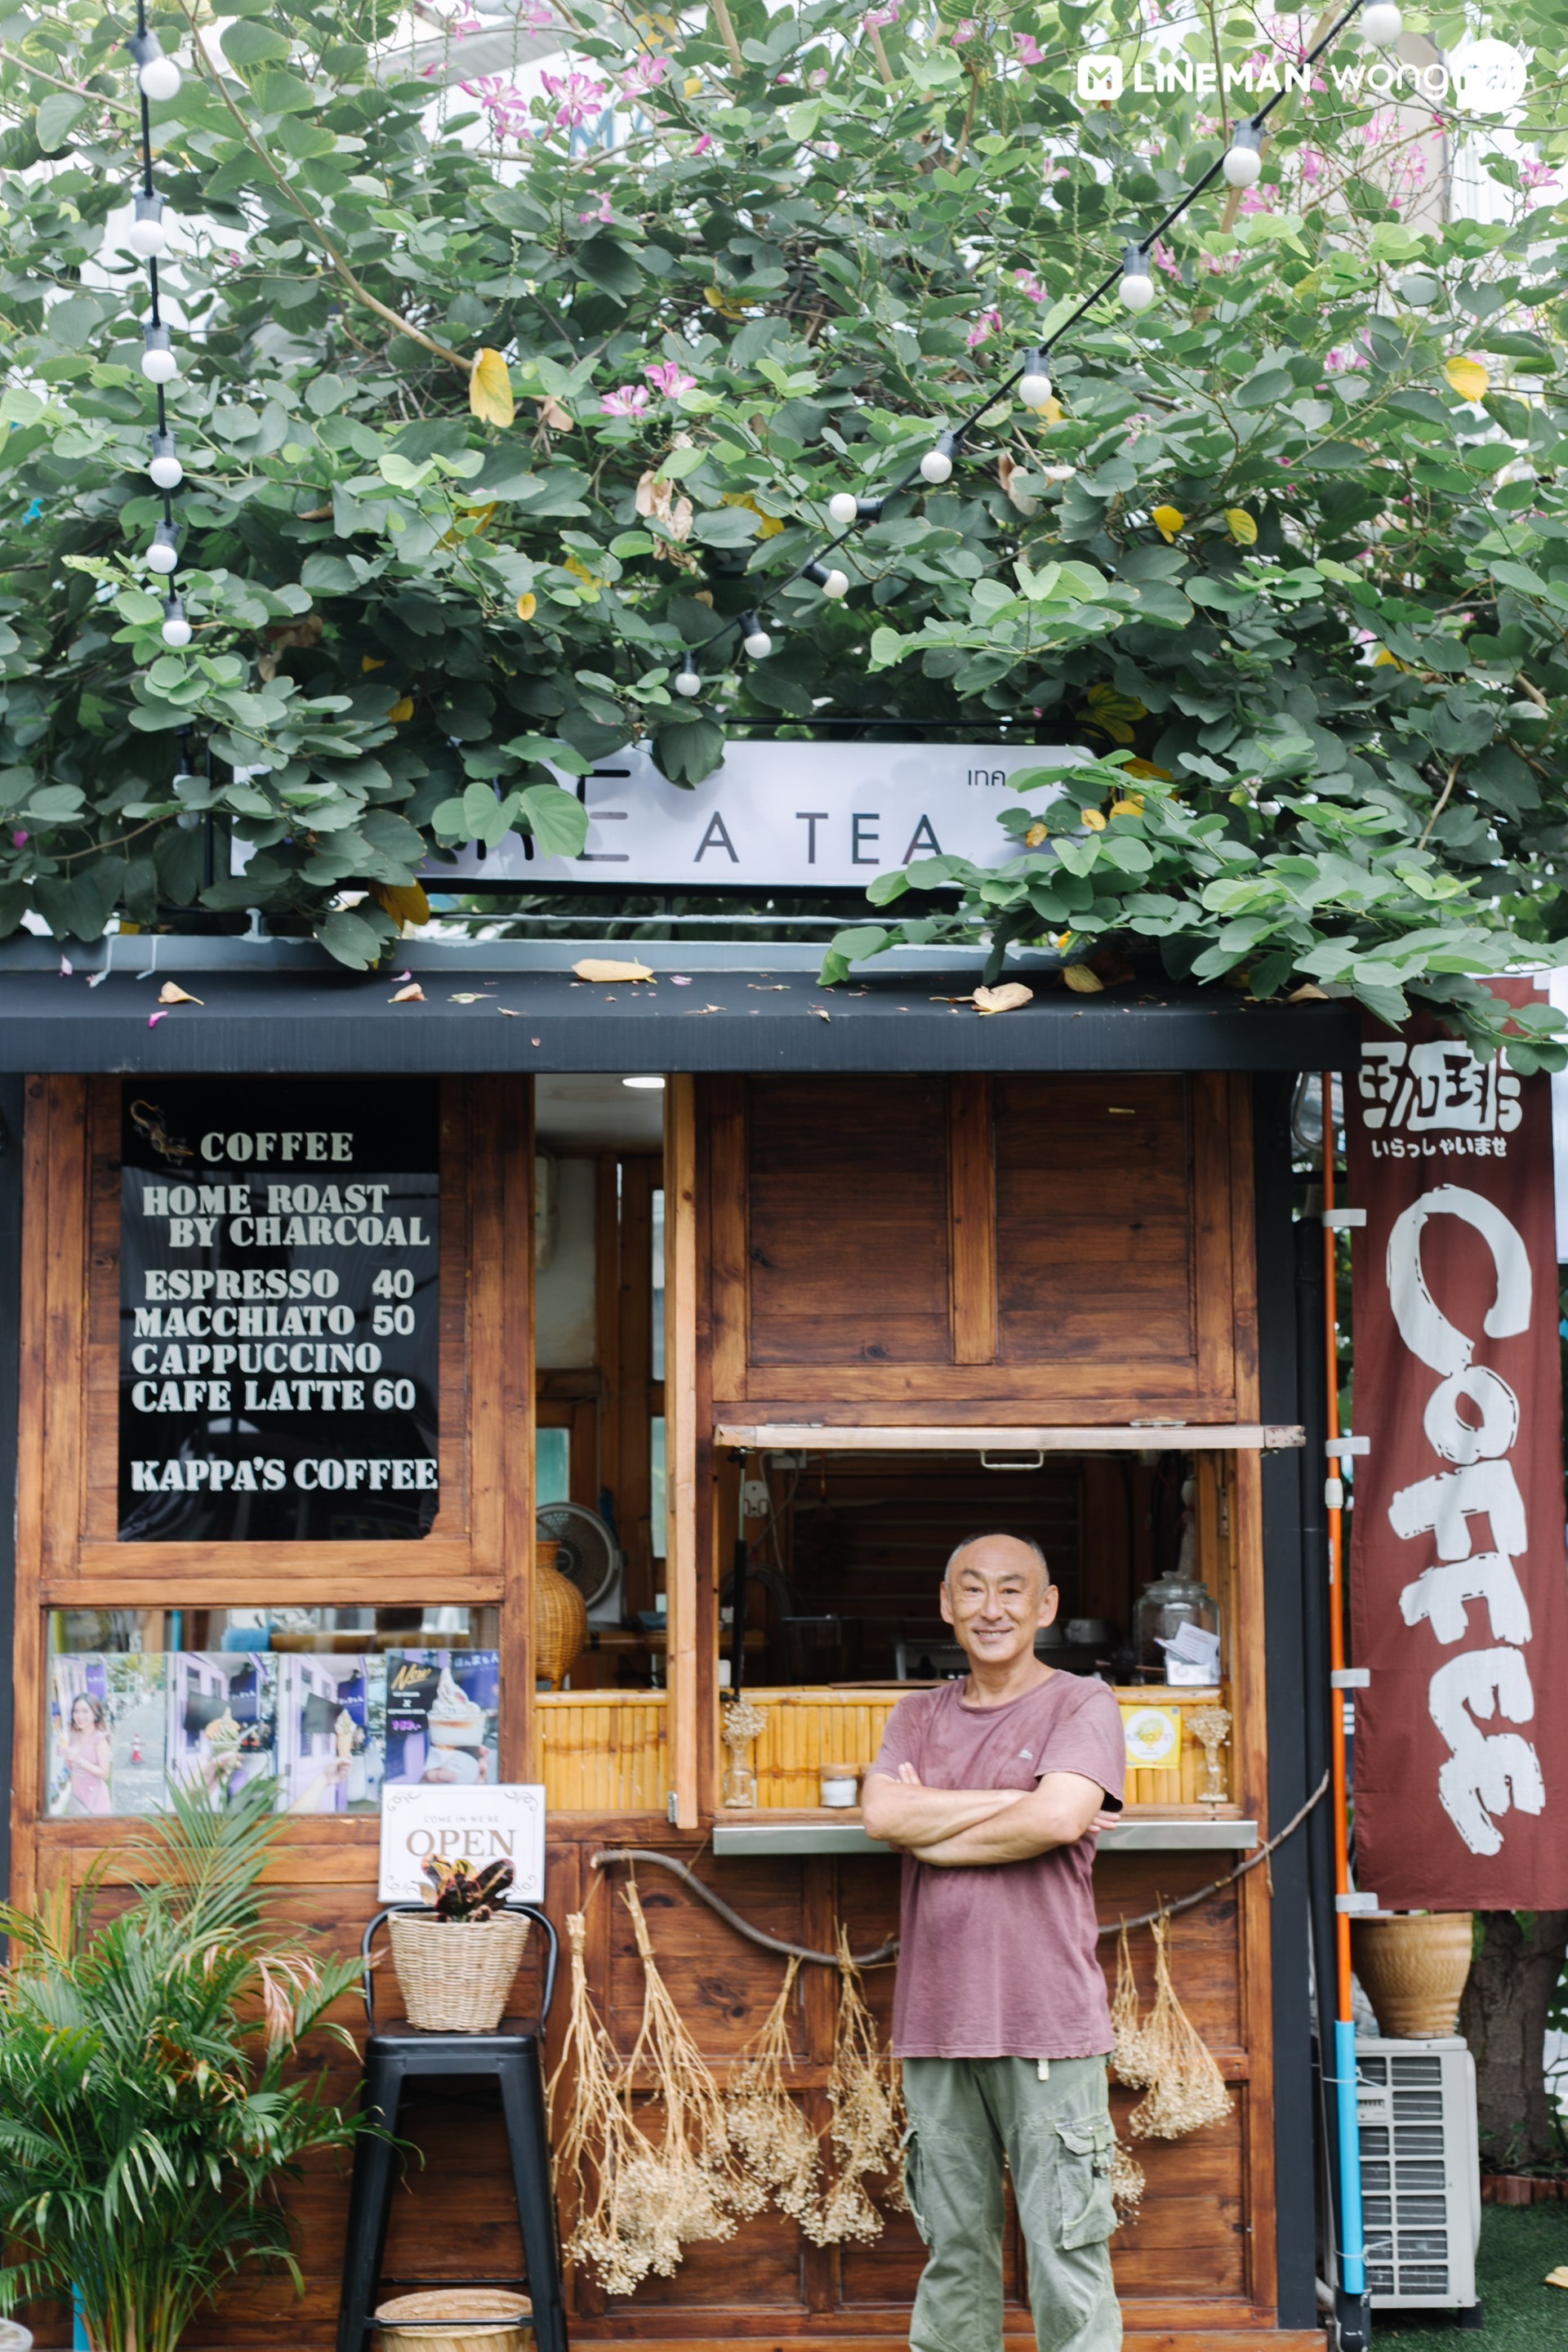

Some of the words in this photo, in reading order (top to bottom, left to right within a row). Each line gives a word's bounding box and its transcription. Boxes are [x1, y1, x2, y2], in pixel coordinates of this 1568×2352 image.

[694, 811, 740, 863] A
[796, 812, 944, 865] TEA
[200, 1132, 354, 1161] COFFEE
[1371, 1135, 1508, 1158] いらっしゃいませ
[142, 1183, 252, 1216] HOME
[267, 1184, 390, 1214] ROAST
[169, 1217, 218, 1247] BY
[229, 1215, 430, 1246] CHARCOAL
[144, 1268, 340, 1301] ESPRESSO
[372, 1268, 415, 1299] 40
[132, 1304, 356, 1338] MACCHIATO
[372, 1304, 415, 1336] 50
[131, 1342, 382, 1375] CAPPUCCINO
[131, 1379, 232, 1413] CAFE
[244, 1379, 365, 1411] LATTE
[372, 1379, 416, 1410] 60
[130, 1455, 287, 1492] KAPPA'S
[293, 1459, 439, 1490] COFFEE
[423, 1815, 452, 1824] COME
[455, 1815, 467, 1824] IN
[405, 1829, 517, 1857] OPEN
